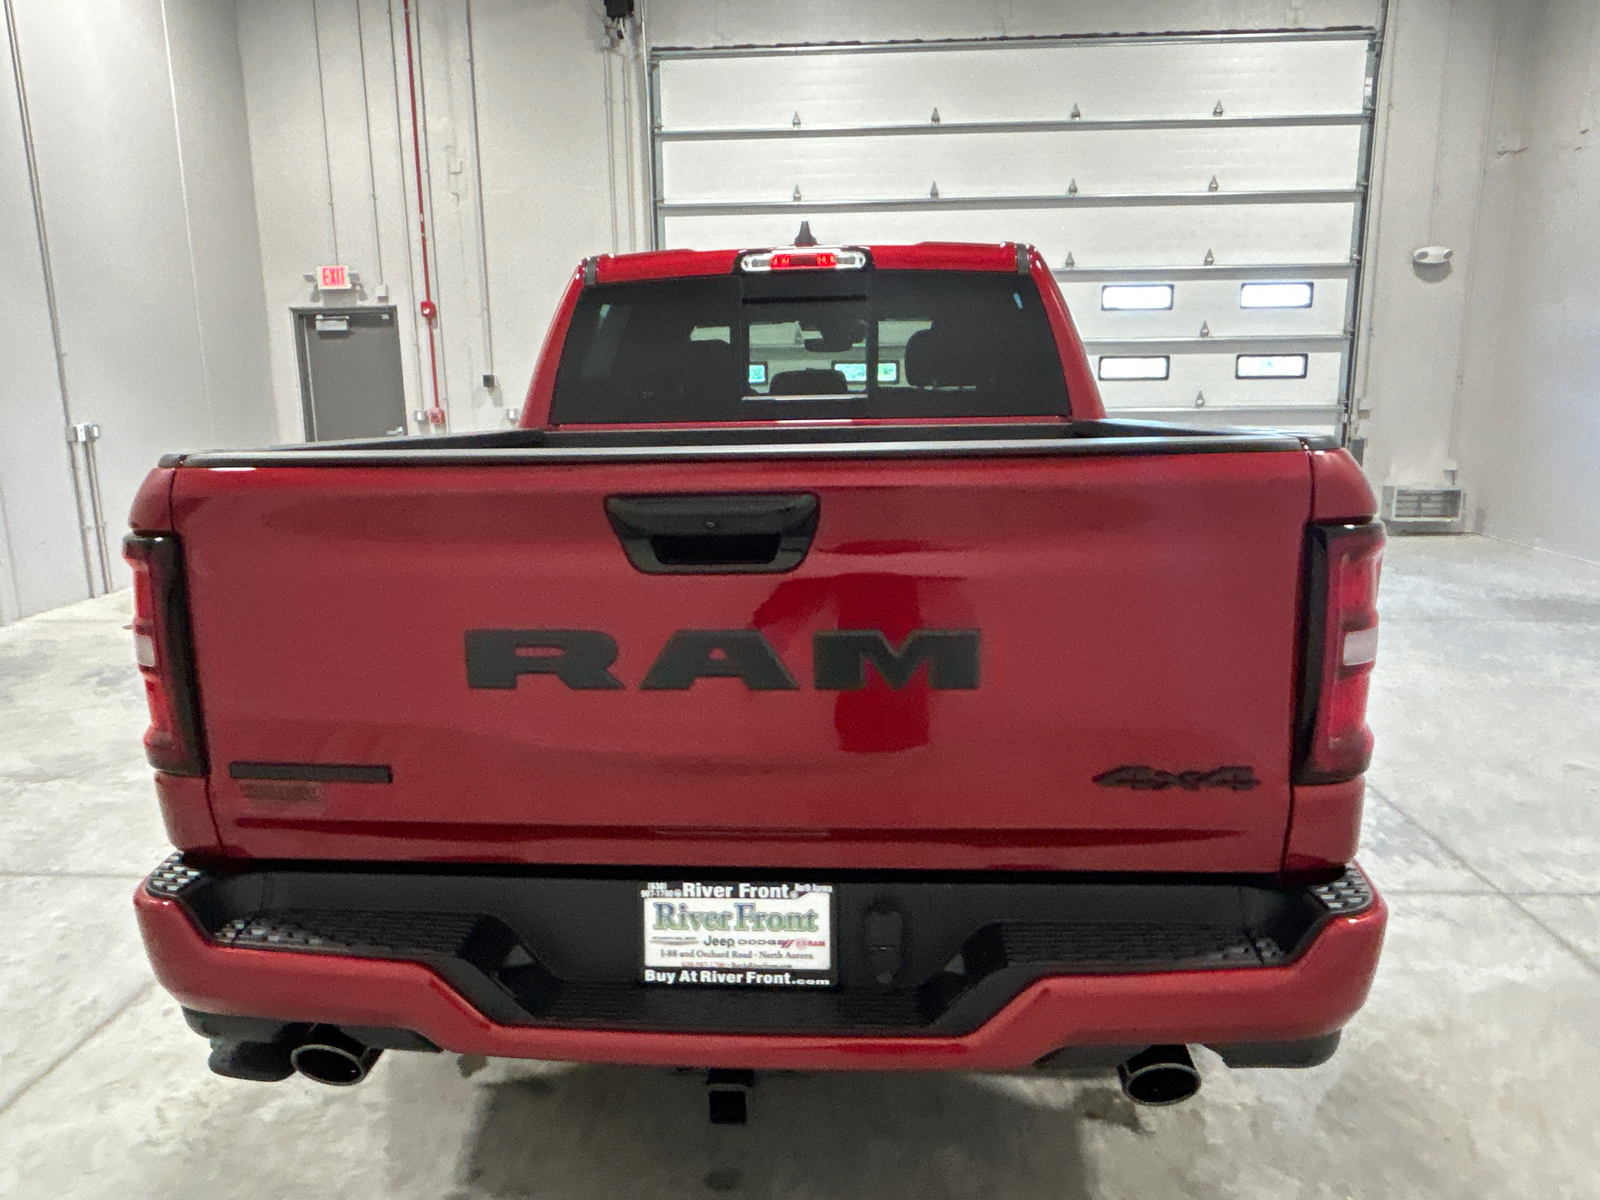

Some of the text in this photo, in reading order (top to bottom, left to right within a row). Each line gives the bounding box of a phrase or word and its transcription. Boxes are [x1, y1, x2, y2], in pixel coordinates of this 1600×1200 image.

[322, 267, 345, 286] EXIT
[464, 628, 982, 691] RAM
[682, 882, 733, 898] River
[739, 883, 789, 898] Front
[653, 902, 819, 932] River Front
[703, 935, 735, 948] Jeep
[680, 949, 695, 958] and
[696, 949, 730, 958] Orchard
[731, 950, 753, 959] Road
[759, 951, 783, 959] North
[785, 951, 813, 959] Aurora
[644, 969, 676, 984] Buy
[679, 970, 698, 983] At
[700, 970, 744, 984] River
